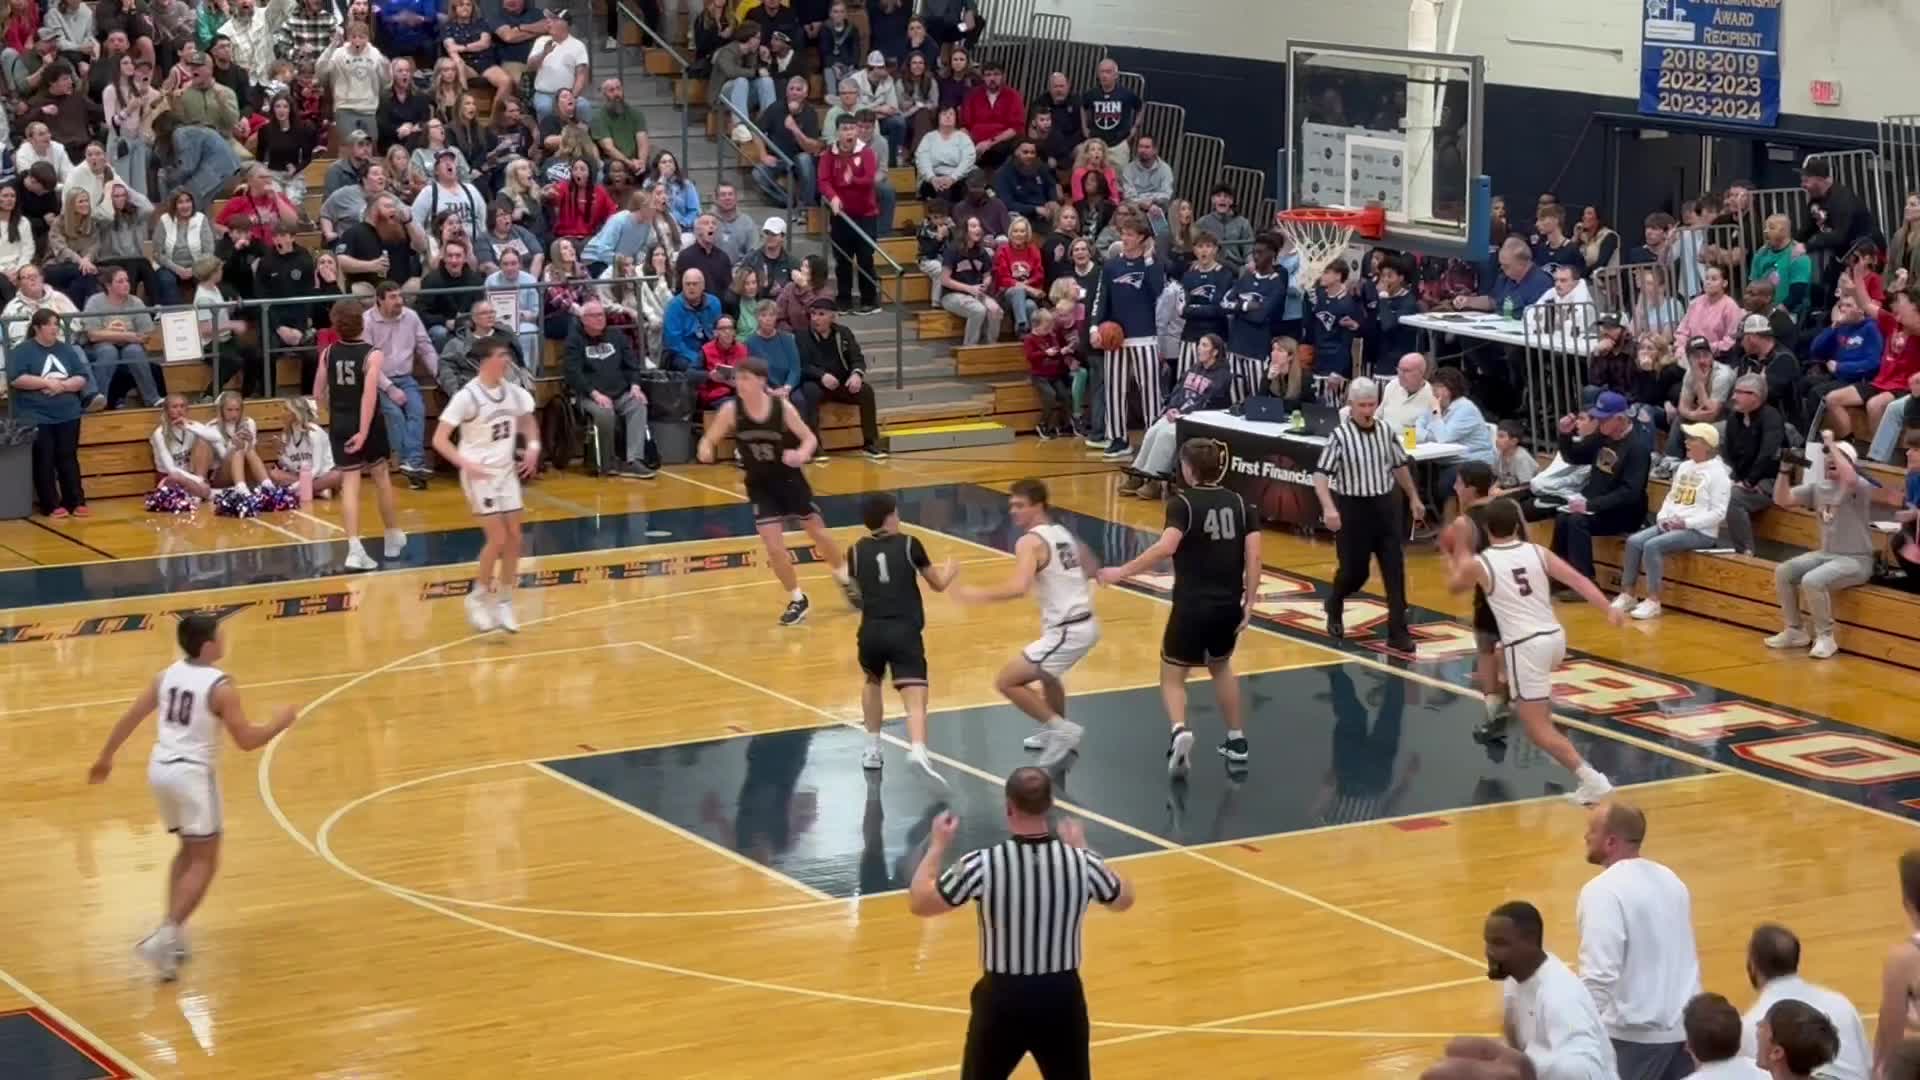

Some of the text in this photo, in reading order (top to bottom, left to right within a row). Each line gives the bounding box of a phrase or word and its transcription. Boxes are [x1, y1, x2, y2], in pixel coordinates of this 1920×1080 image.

[1712, 7, 1754, 27] AWARD
[1703, 27, 1763, 47] RECIPIENT
[1661, 48, 1759, 74] 2018-2019
[1657, 71, 1761, 97] 2022-2023
[1094, 100, 1122, 113] THN
[1657, 93, 1761, 120] 2023-2024
[335, 360, 356, 386] 15
[491, 420, 511, 441] 23
[1230, 455, 1260, 476] First
[1261, 462, 1313, 486] Financia
[1202, 506, 1236, 541] 40
[875, 551, 891, 584] 1
[1511, 567, 1533, 597] 5
[1119, 566, 1920, 809] PATRIO
[166, 686, 196, 727] 10
